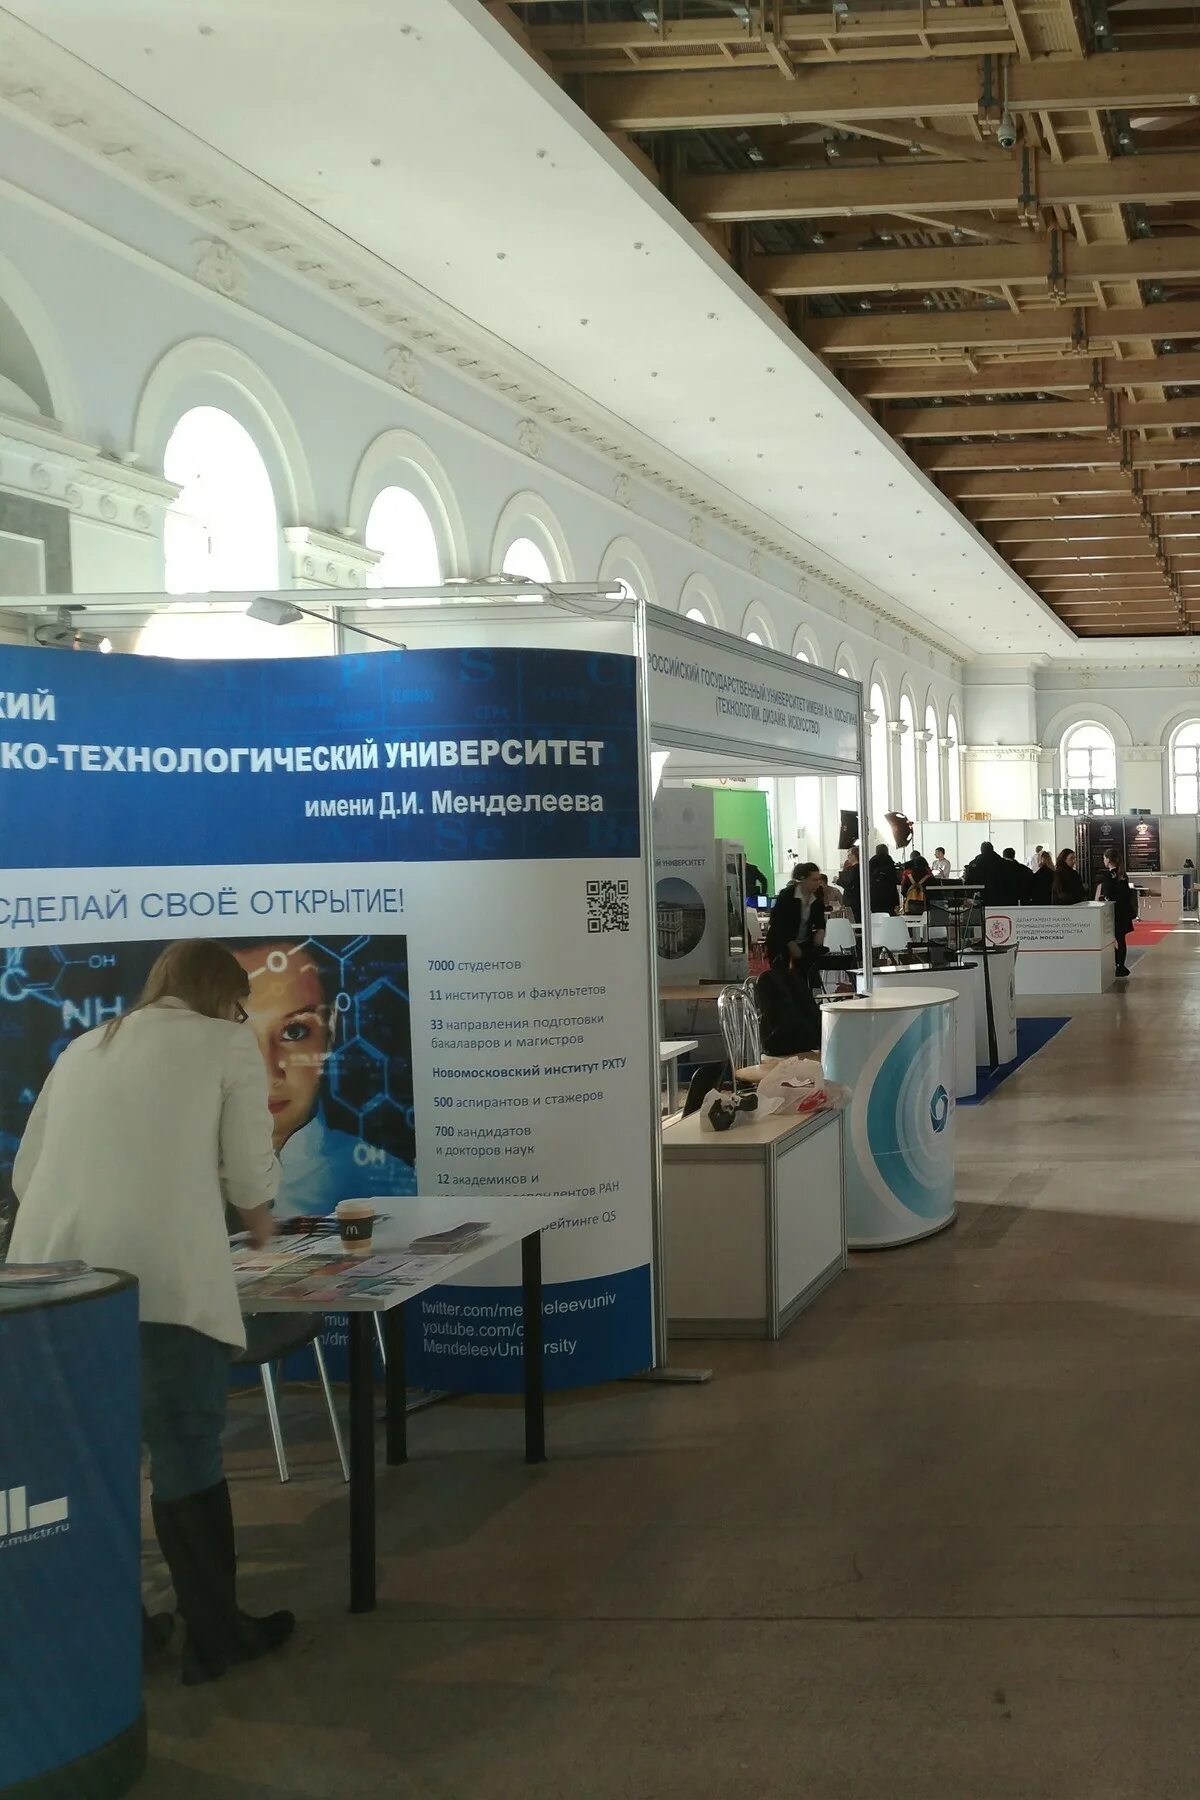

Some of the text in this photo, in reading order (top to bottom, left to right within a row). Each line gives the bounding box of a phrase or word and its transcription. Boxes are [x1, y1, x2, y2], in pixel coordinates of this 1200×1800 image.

[700, 667, 766, 701] ГОСУДАРСТВЕННЫЙ
[767, 687, 806, 712] УНИВЕРСИТЕТ
[0, 738, 604, 774] КО-ТЕХНОЛОГИЧЕСКИЙ УНИВЕРСИТЕТ
[304, 789, 604, 819] имени Д.И. Менделеева
[140, 886, 239, 919] СВОЁ
[250, 887, 405, 916] ОТКРЫТИЕ!
[428, 960, 522, 973] 7000 студентов
[429, 985, 606, 1003] 11 институтов и факультетов
[430, 1014, 604, 1032] 33 направления подготовки
[431, 1034, 584, 1051] бакалавров и магистров
[432, 1056, 627, 1079] Новомосковский институт РХТУ
[433, 1091, 604, 1110] 500 аспирантов и стажеров
[435, 1125, 531, 1139] 700 кандидатов
[436, 1144, 535, 1158] и докторов наук
[437, 1173, 540, 1186] 12 академиков и
[599, 1180, 620, 1194] РАН
[602, 1210, 617, 1224] QS
